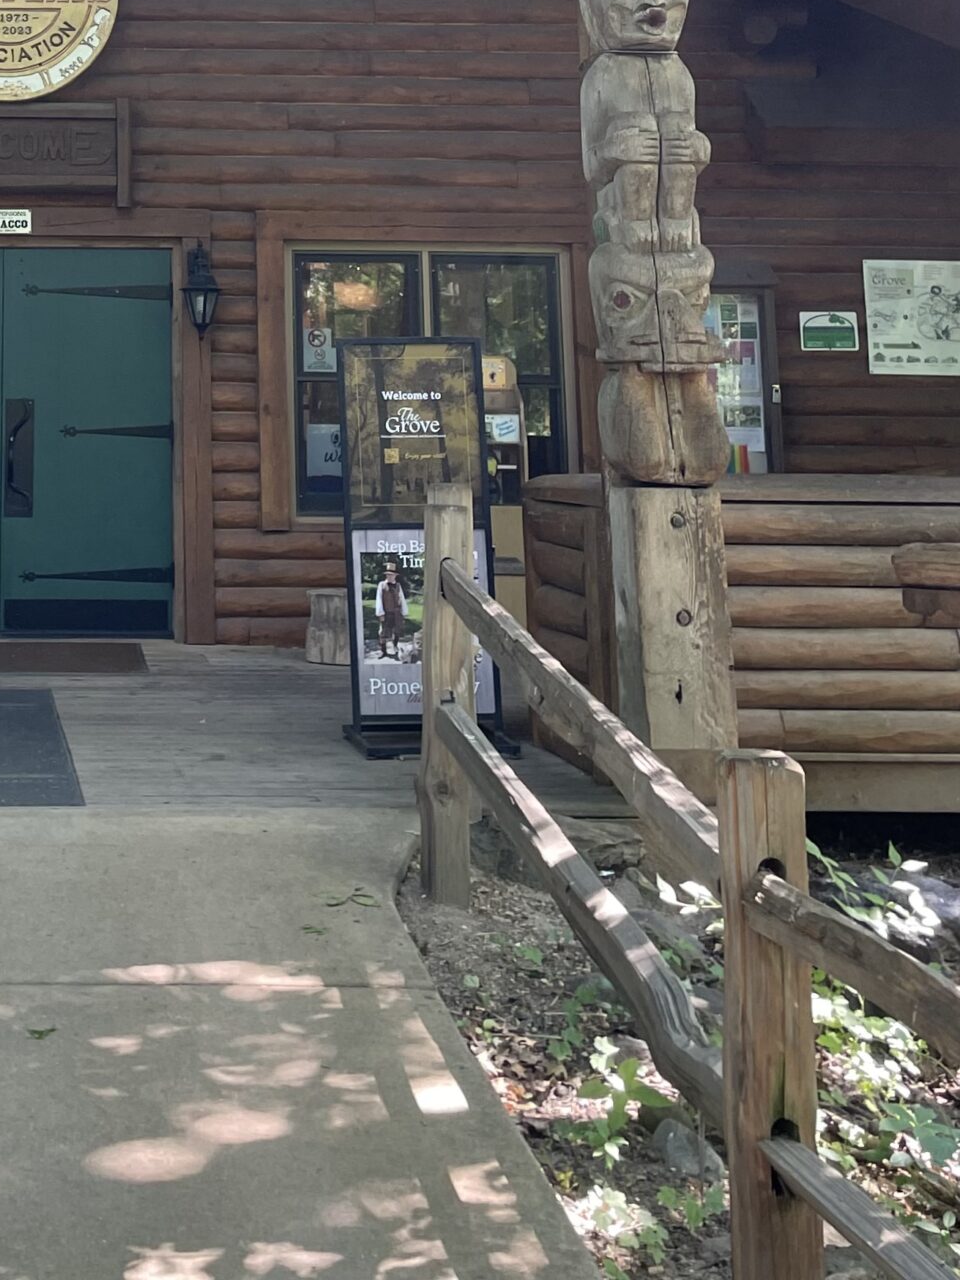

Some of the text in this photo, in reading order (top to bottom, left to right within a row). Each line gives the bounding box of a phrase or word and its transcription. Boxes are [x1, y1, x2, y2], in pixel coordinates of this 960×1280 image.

[2, 26, 32, 35] 2023
[381, 390, 441, 400] Welcome to
[397, 407, 420, 421] The
[385, 416, 440, 433] Grove
[377, 540, 425, 556] Step Ba
[369, 678, 423, 695] Pione
